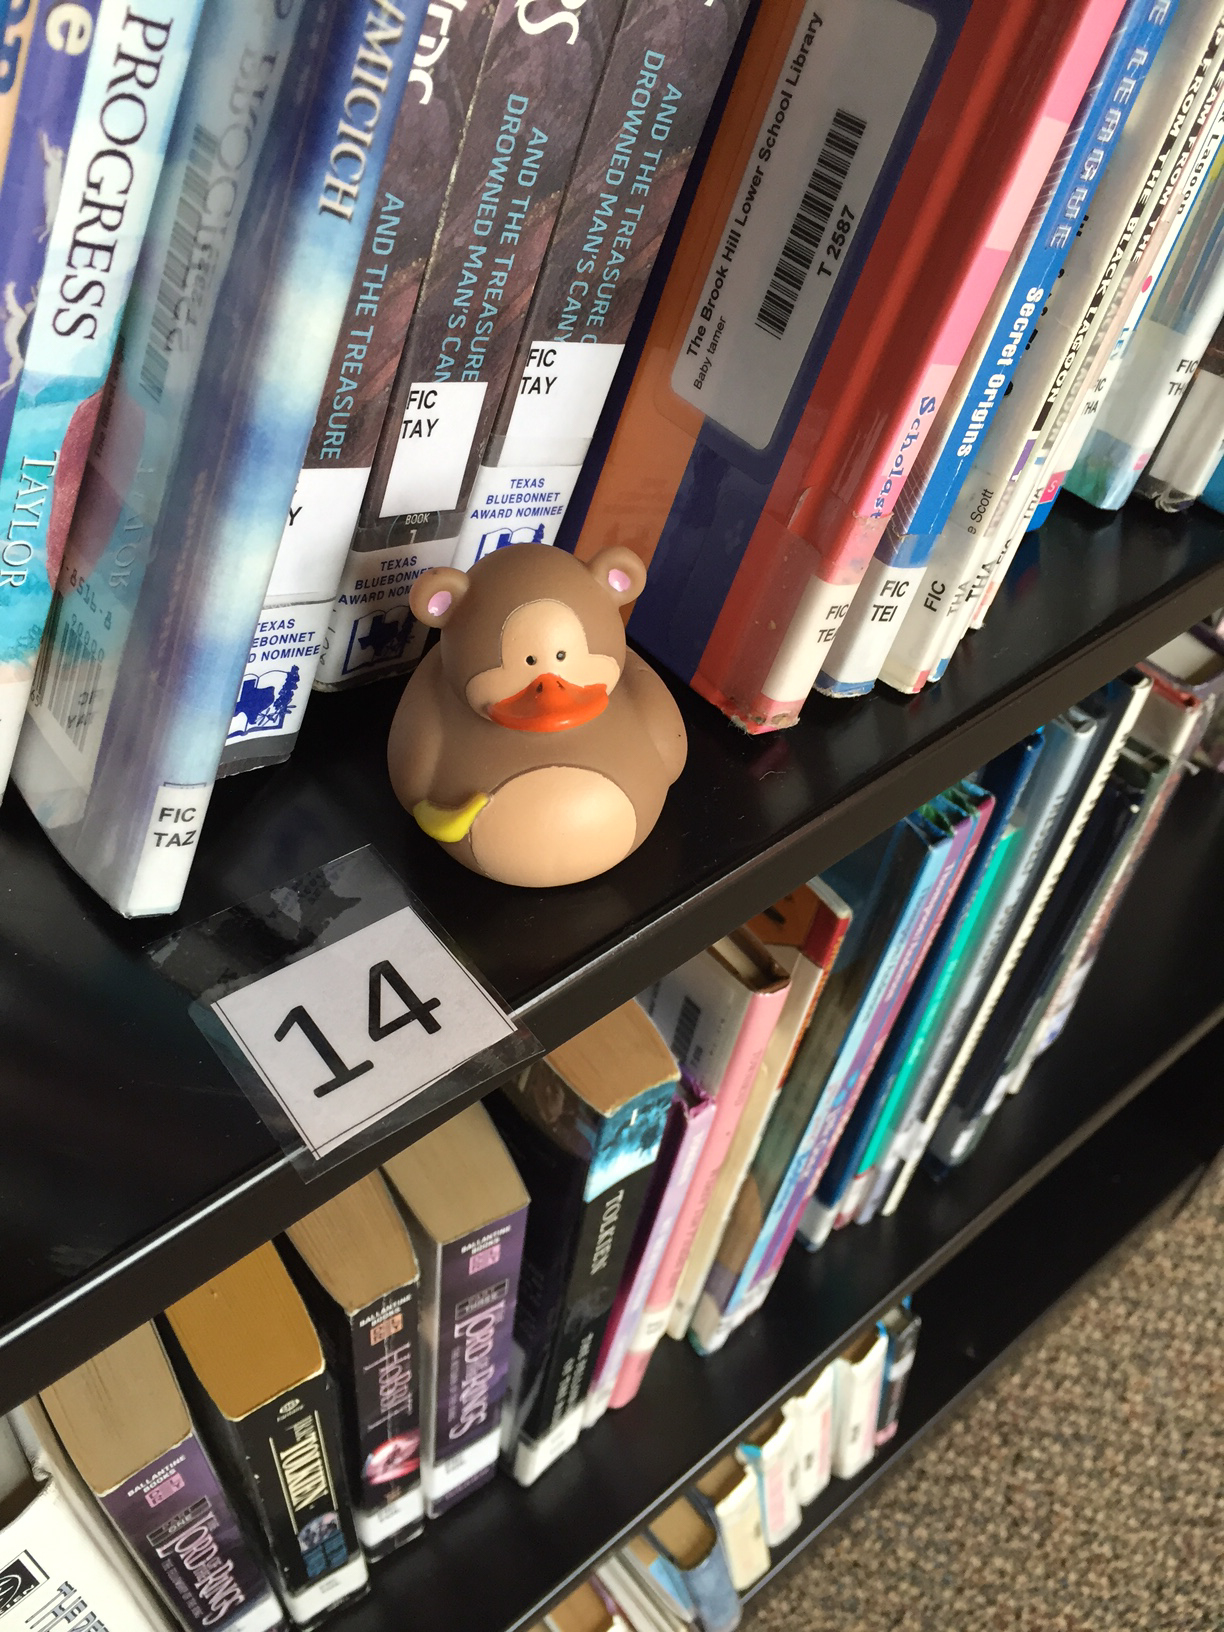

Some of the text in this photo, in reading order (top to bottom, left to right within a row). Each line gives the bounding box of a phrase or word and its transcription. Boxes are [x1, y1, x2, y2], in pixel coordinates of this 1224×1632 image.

[605, 50, 666, 187] DROWNED
[651, 83, 683, 142] AND
[1170, 58, 1212, 137] FROM
[52, 4, 174, 341] PROGRESS
[474, 94, 529, 237] DROWNED
[630, 149, 663, 197] THE
[686, 12, 824, 358] The Brook Hill Lower School Library
[1138, 150, 1170, 206] THE
[1176, 134, 1219, 215] Lagoon
[460, 127, 548, 382] AND THE TREASURE
[576, 193, 619, 277] MAN'S
[817, 205, 857, 279] T 2587
[1097, 217, 1139, 295] BLACK
[1131, 221, 1155, 263] THE
[445, 245, 487, 330] MAN'S
[589, 204, 645, 327] TREASURE
[319, 192, 405, 461] AND THE TREASURE
[997, 286, 1044, 367] Secret
[526, 349, 558, 369] FIC
[693, 316, 727, 391] Baby tamer
[1047, 306, 1098, 403] LAGOON
[1176, 359, 1199, 374] FIC
[406, 389, 438, 411] FIC
[520, 377, 558, 396] TAY
[1168, 381, 1188, 396] TH
[401, 418, 439, 439] TAY
[870, 396, 937, 519] Scholast
[486, 491, 561, 505] BLUEBONNET
[510, 478, 545, 489] TEXAS
[970, 488, 994, 524] Scott
[0, 450, 59, 590] TAYLOR
[404, 513, 430, 525] BOOK
[470, 505, 564, 520] AWARD NOMINEE
[355, 567, 434, 590] BLUEBONN
[381, 556, 417, 571] TEXAS
[338, 590, 385, 605] AWARD
[825, 603, 849, 620] FIC
[880, 580, 910, 598] FIC
[924, 580, 946, 612] FIC
[871, 604, 898, 622] TEI
[252, 631, 316, 648] EBONNET
[261, 644, 321, 661] NOMINEE
[158, 806, 197, 825] FIC
[153, 830, 197, 849] TAZ
[274, 959, 442, 1098] 14
[590, 1190, 624, 1276] TOLKIEN
[127, 1454, 187, 1497] BALLANTINE
[142, 1468, 177, 1493] BOOKS
[280, 1431, 329, 1512] TOLKIEN
[155, 1511, 219, 1570] LORD
